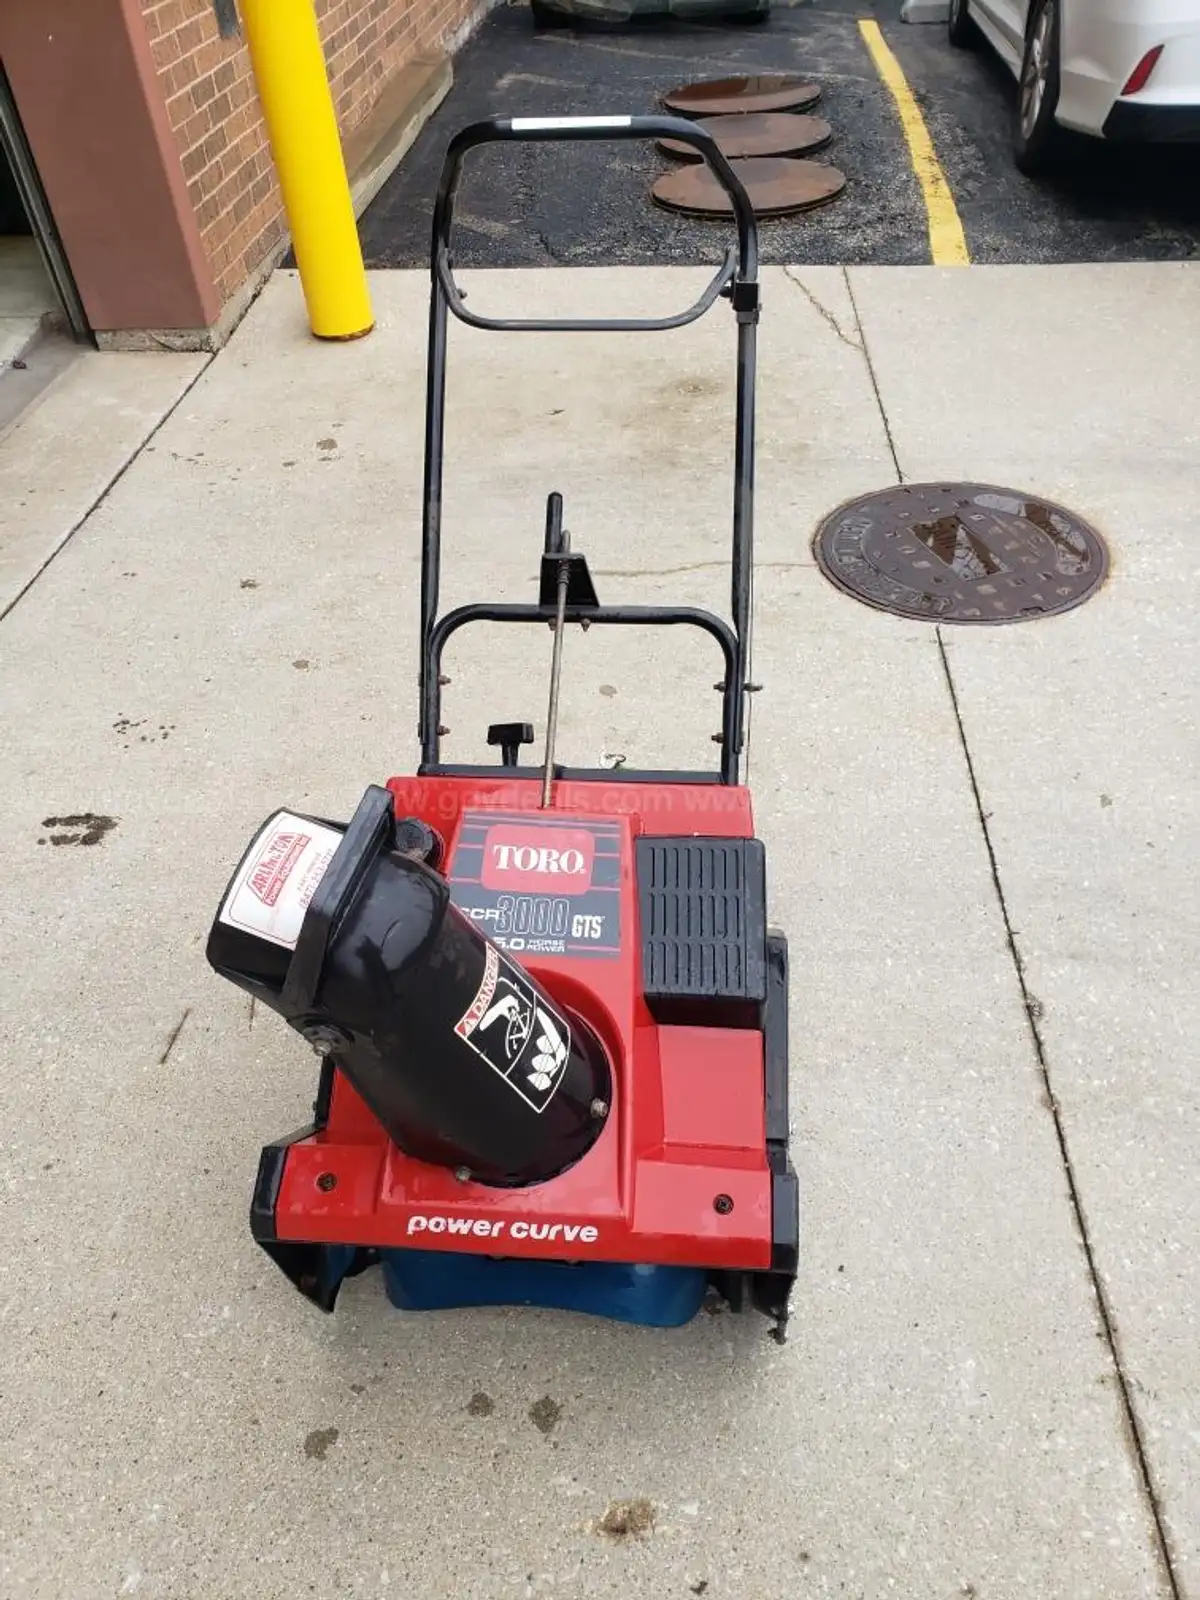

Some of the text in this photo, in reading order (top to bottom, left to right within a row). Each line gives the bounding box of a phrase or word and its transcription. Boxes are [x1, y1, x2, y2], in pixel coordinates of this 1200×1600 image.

[493, 844, 585, 874] TORO
[571, 915, 602, 939] GTS
[526, 944, 566, 952] POWER
[475, 948, 499, 1014] DANGER
[406, 1215, 599, 1243] power curve
